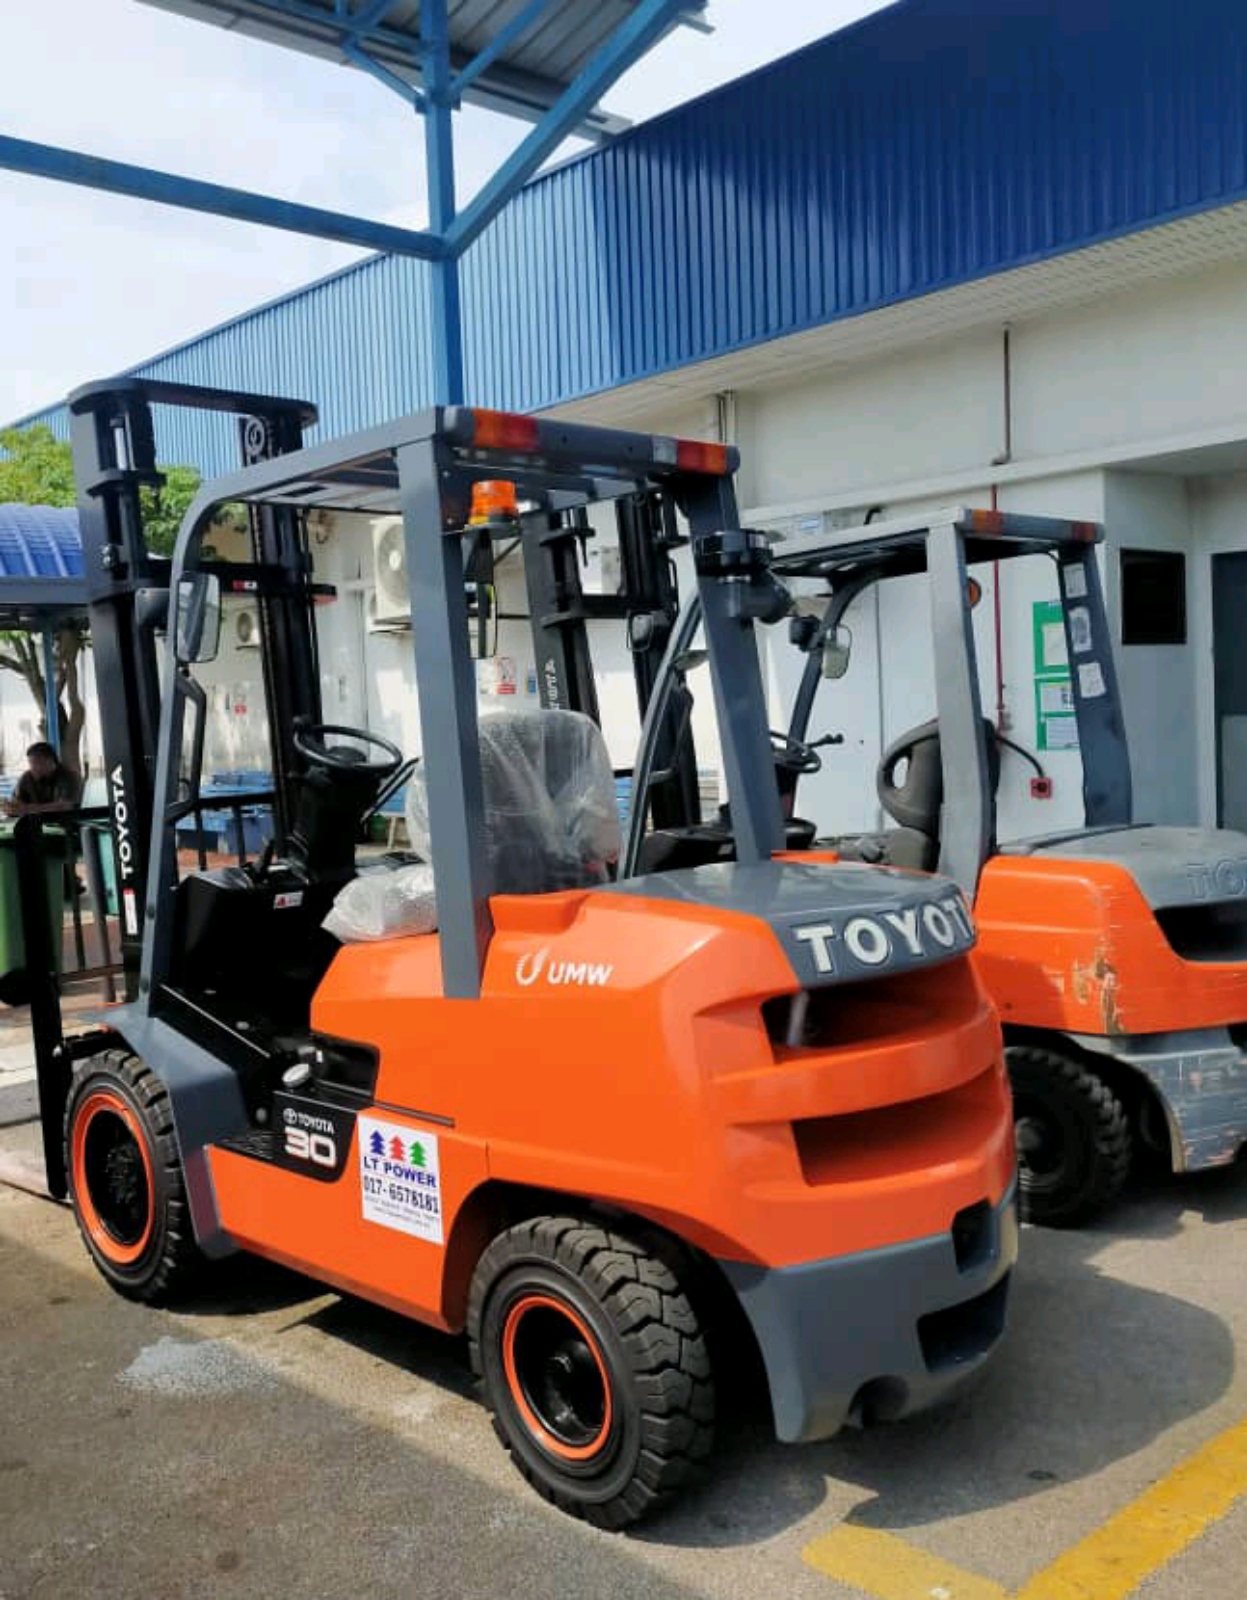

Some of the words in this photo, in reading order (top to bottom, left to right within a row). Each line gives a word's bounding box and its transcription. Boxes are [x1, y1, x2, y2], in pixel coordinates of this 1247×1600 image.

[111, 764, 134, 880] TOYOTA
[795, 895, 971, 972] TOYOT
[547, 962, 613, 986] UMW
[297, 1112, 335, 1135] TOYOTA
[284, 1126, 336, 1168] 30
[364, 1156, 379, 1170] LT
[384, 1160, 436, 1188] POWER
